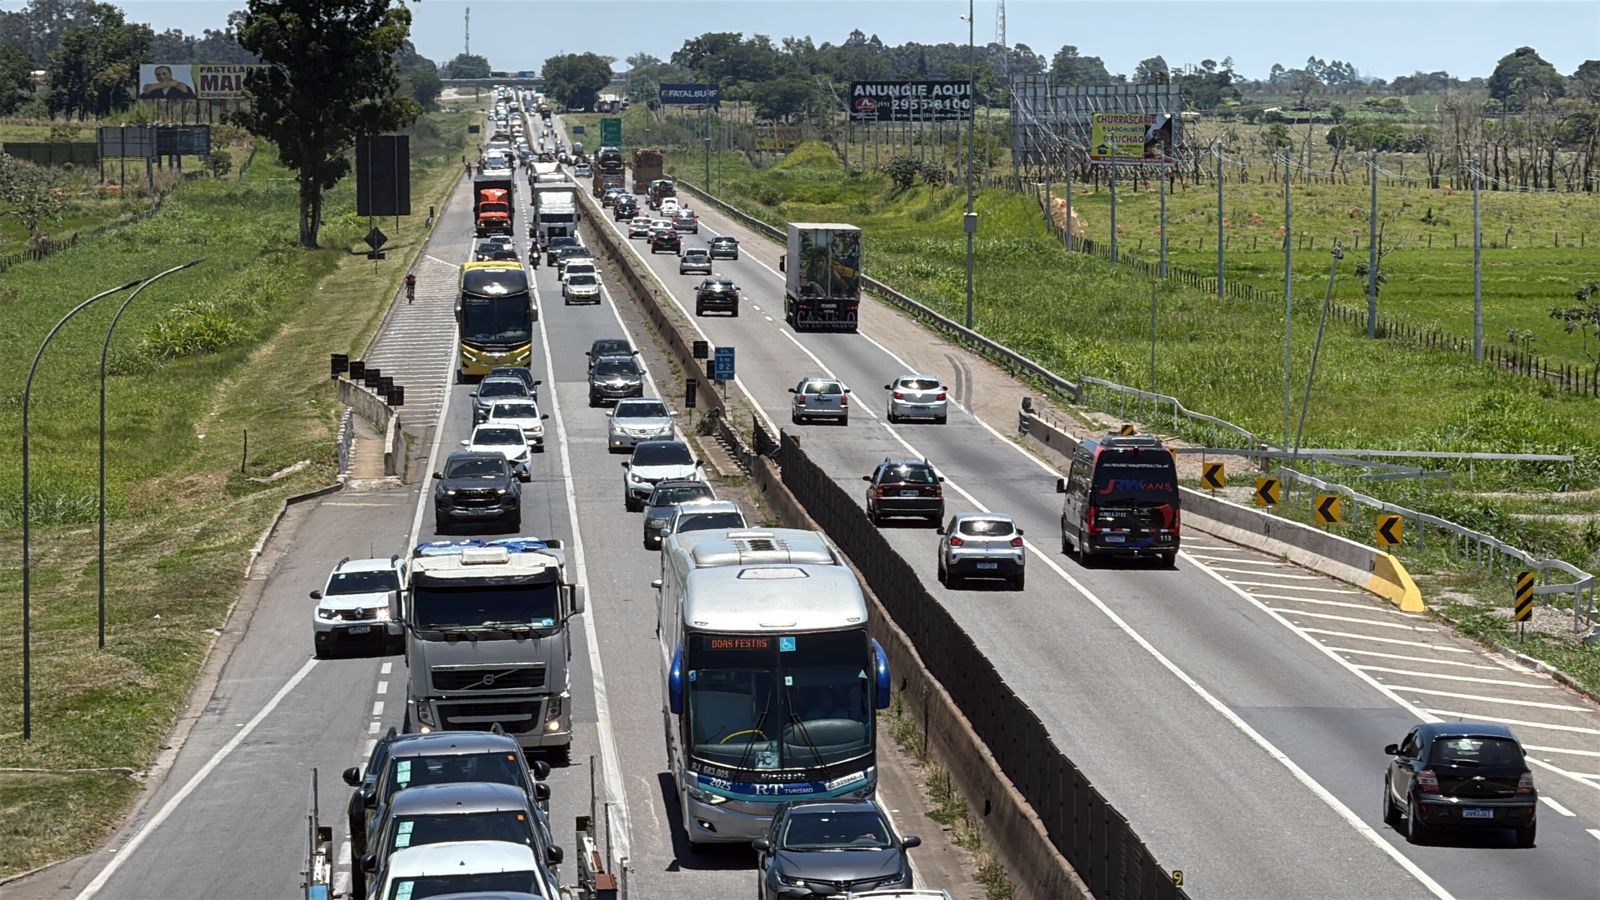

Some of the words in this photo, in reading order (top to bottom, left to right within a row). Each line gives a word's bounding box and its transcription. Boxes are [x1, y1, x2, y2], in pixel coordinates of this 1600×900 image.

[200, 75, 243, 91] MAI
[854, 85, 928, 96] ANUNCIE
[932, 85, 971, 96] AQUI
[712, 640, 733, 649] BOAS
[735, 639, 768, 648] FESTAS
[710, 777, 733, 791] 2025
[754, 783, 784, 795] RT
[1173, 871, 1182, 885] 9
